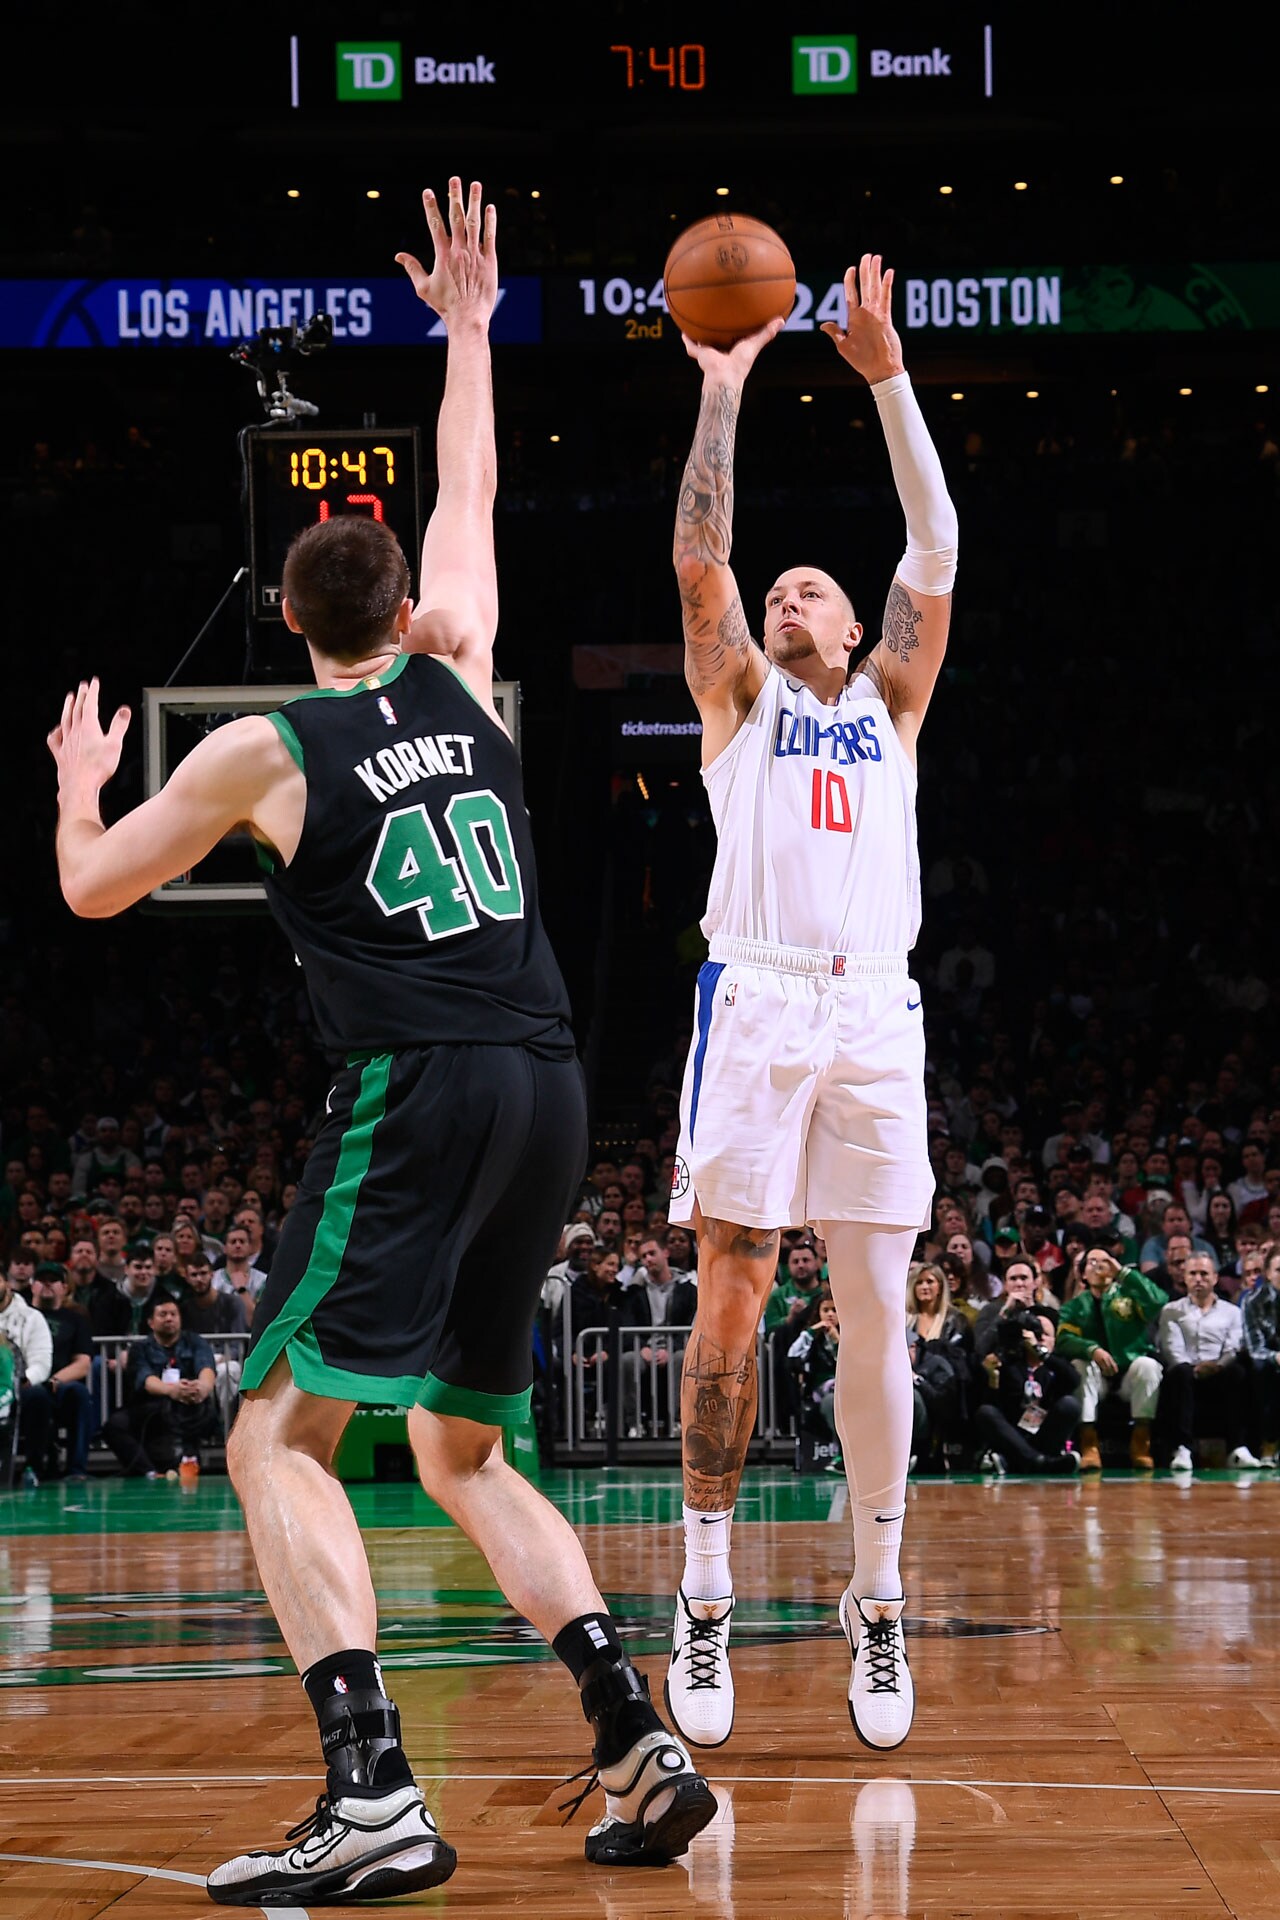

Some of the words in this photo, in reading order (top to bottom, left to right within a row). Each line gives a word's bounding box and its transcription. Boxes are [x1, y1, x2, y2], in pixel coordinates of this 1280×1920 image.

[343, 53, 395, 89] TD
[415, 55, 496, 84] Bank
[611, 45, 705, 89] 7:40
[799, 46, 851, 82] TD
[870, 47, 951, 77] Bank
[118, 289, 189, 338] LOS
[205, 288, 371, 337] ANGELES
[579, 277, 669, 316] 10:4
[906, 276, 1060, 328] BOSTON
[624, 316, 663, 339] 2nd
[290, 447, 395, 489] 10:47
[621, 721, 702, 736] ticketmaste
[773, 707, 882, 765] CLIPPRS
[354, 734, 475, 803] KORNET
[811, 768, 852, 833] 10
[365, 789, 525, 941] 40
